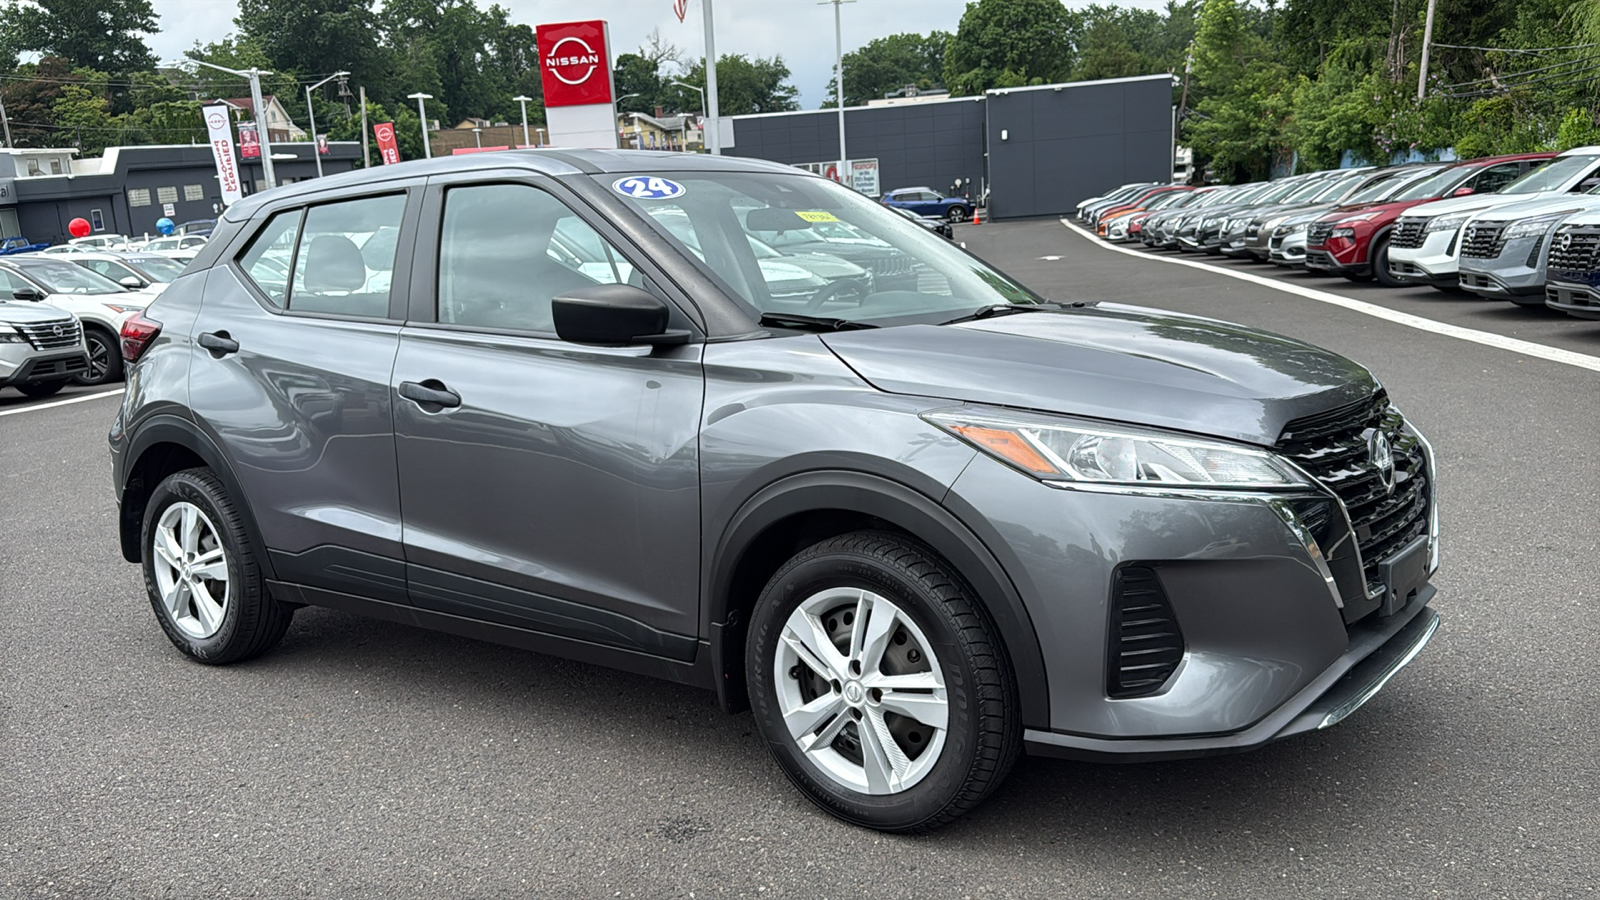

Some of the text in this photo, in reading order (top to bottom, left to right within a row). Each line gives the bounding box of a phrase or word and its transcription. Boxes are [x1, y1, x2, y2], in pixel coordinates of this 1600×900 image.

[546, 54, 599, 67] NISSAN
[624, 178, 673, 197] 24
[754, 578, 797, 731] TOURING A/S
